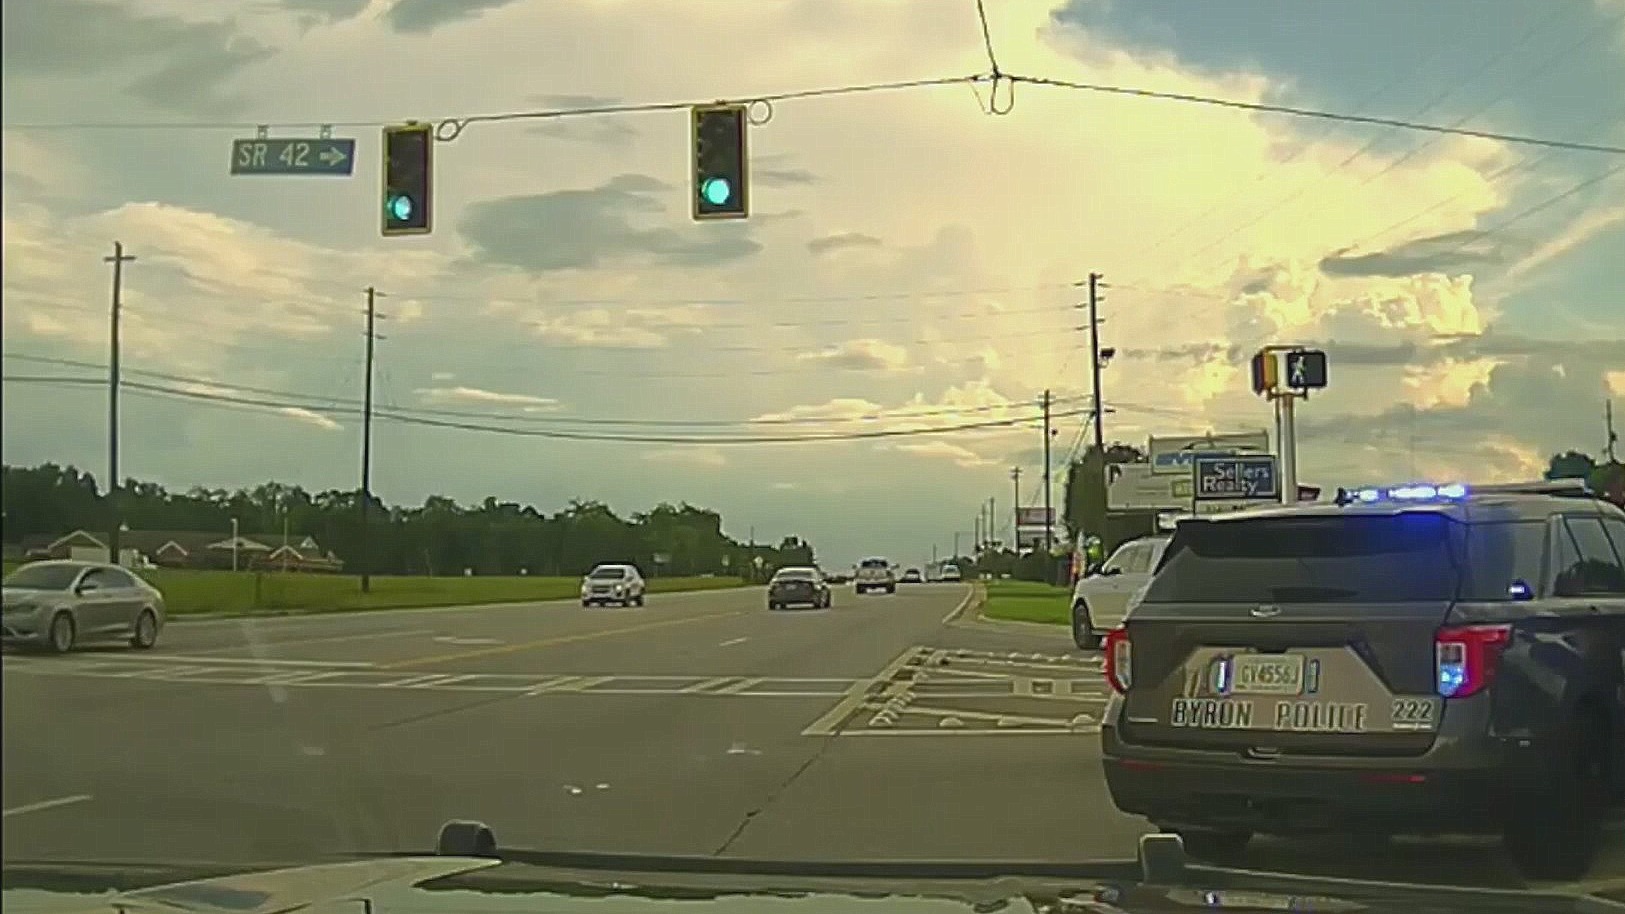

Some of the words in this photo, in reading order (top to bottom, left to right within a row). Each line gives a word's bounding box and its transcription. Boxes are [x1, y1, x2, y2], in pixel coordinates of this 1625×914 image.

[240, 143, 267, 166] SR
[280, 142, 310, 166] 42
[1213, 462, 1269, 480] Sellers
[1203, 476, 1257, 496] Realty
[1172, 699, 1253, 728] BYRON
[1393, 699, 1433, 720] 222
